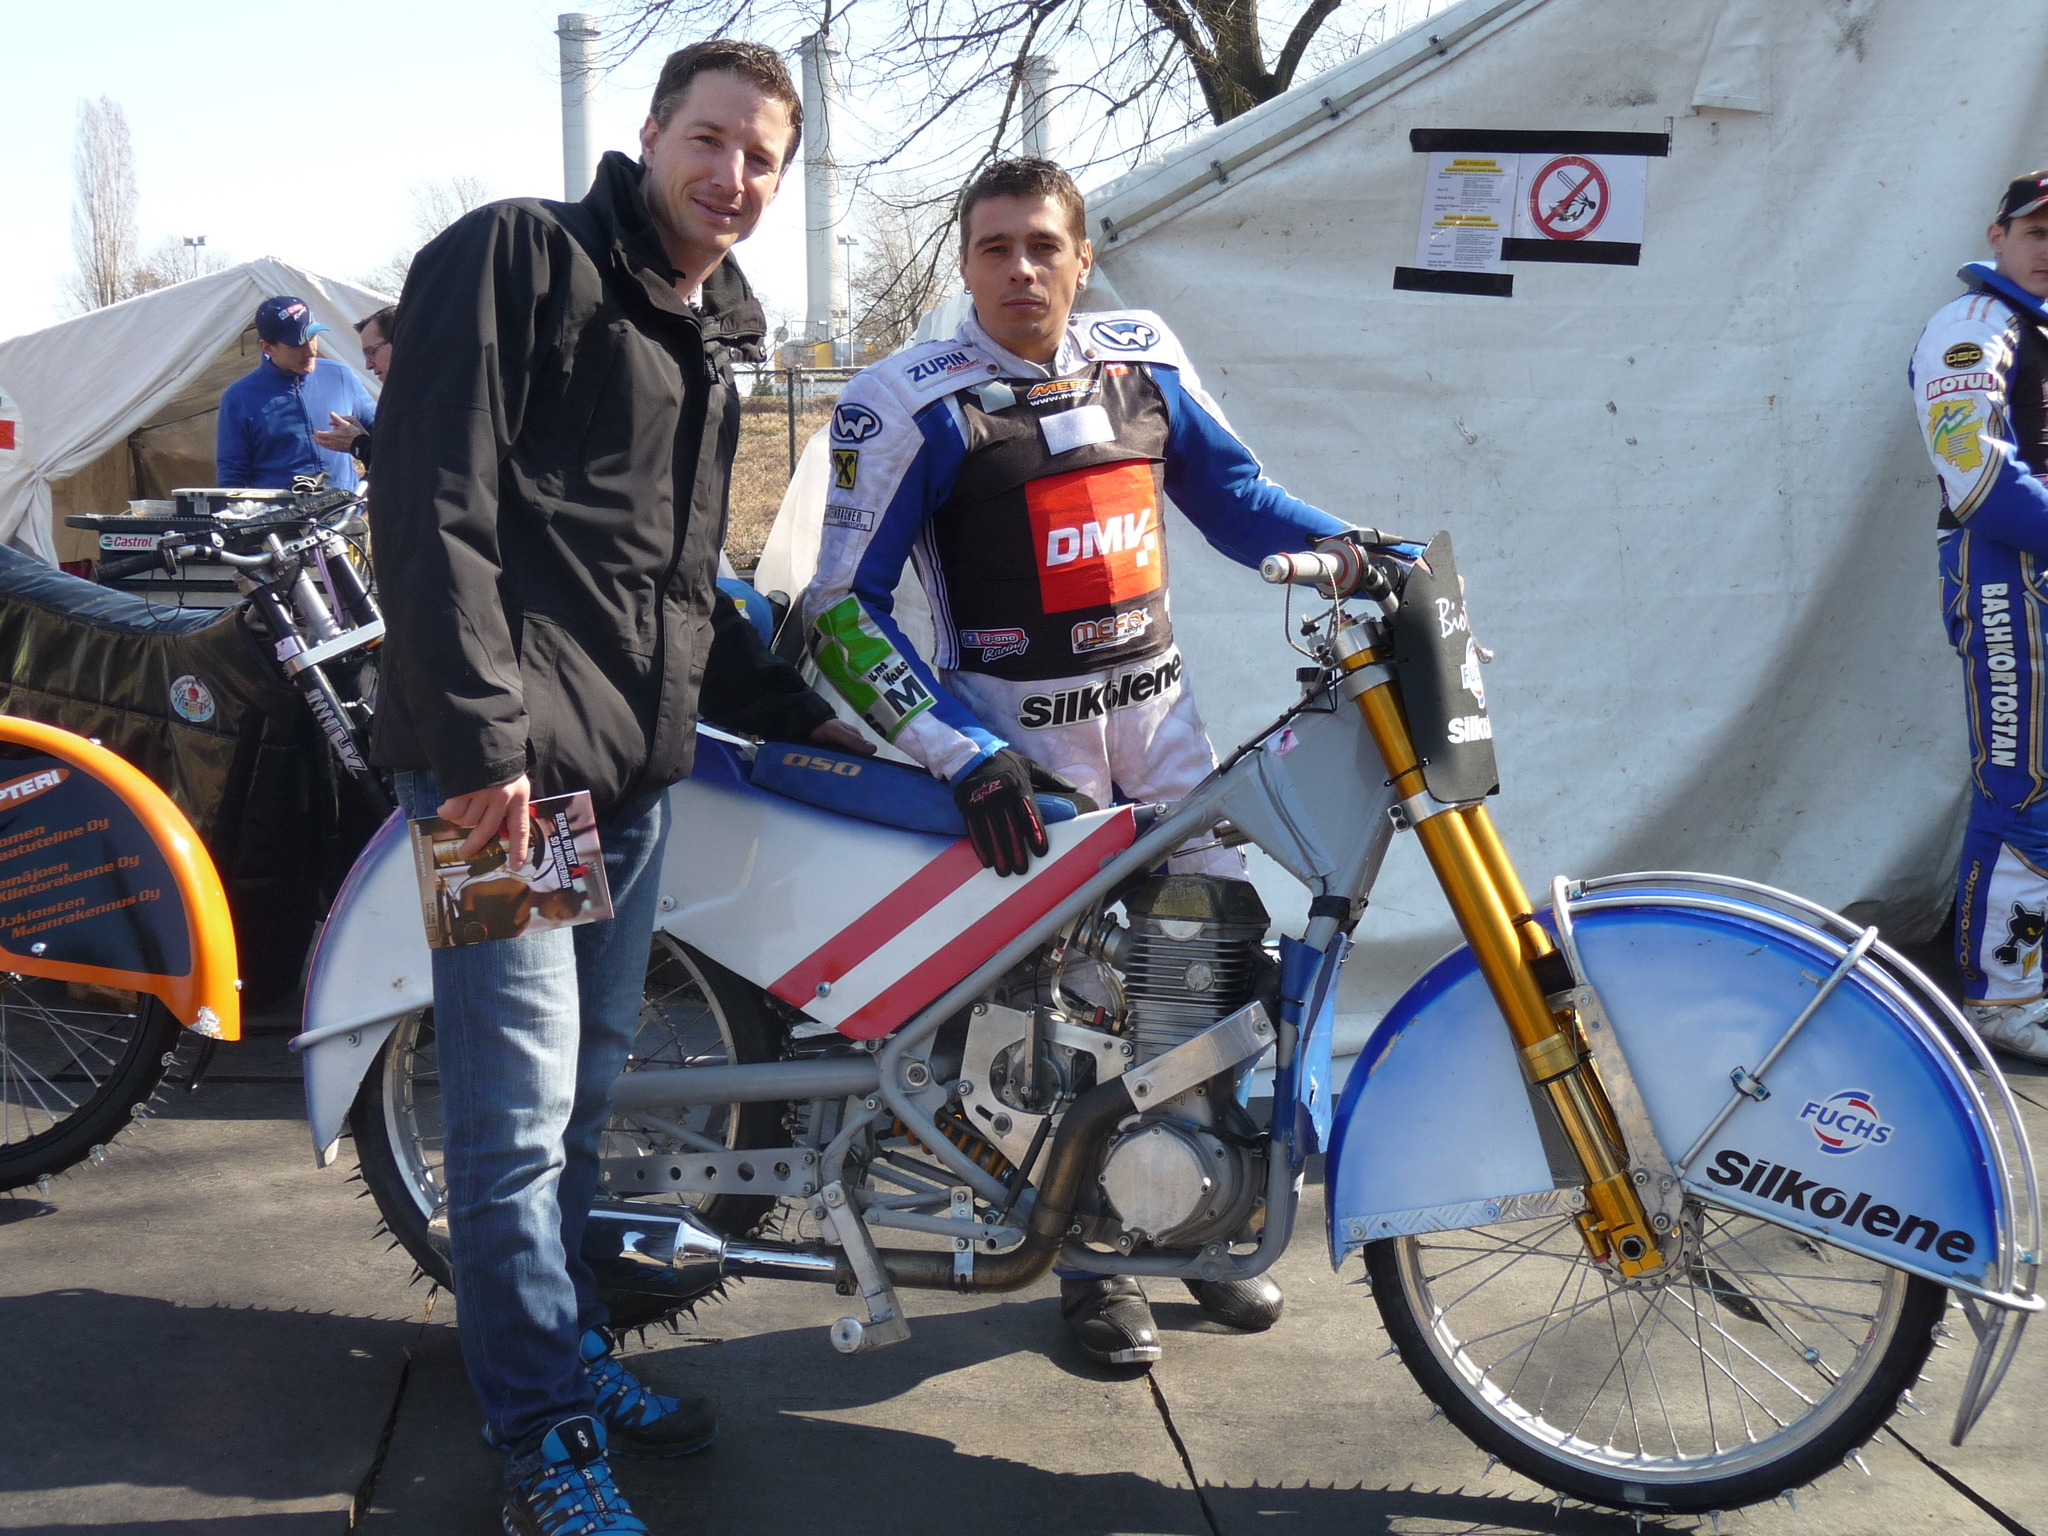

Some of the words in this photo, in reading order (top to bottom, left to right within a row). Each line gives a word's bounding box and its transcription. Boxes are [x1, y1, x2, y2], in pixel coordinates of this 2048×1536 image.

[907, 352, 970, 382] ZUPIN
[1928, 375, 1993, 399] MOTUL
[114, 536, 153, 548] Castrol
[1046, 508, 1151, 567] DMV
[983, 635, 1016, 643] Q-one
[985, 640, 1026, 660] Racing
[1981, 583, 2018, 767] BASHKORTOSTAN
[1019, 656, 1181, 728] Silkolene
[87, 818, 109, 832] Oy
[555, 812, 569, 840] BERLIN,
[549, 836, 560, 846] SO
[562, 839, 573, 850] DU
[118, 855, 140, 868] Oy
[553, 845, 571, 888] WUNDERBAR
[564, 850, 577, 866] BIST
[139, 888, 160, 901] Oy
[1800, 1102, 1892, 1143] FUCHS
[1706, 1150, 1976, 1263] Silkolene
